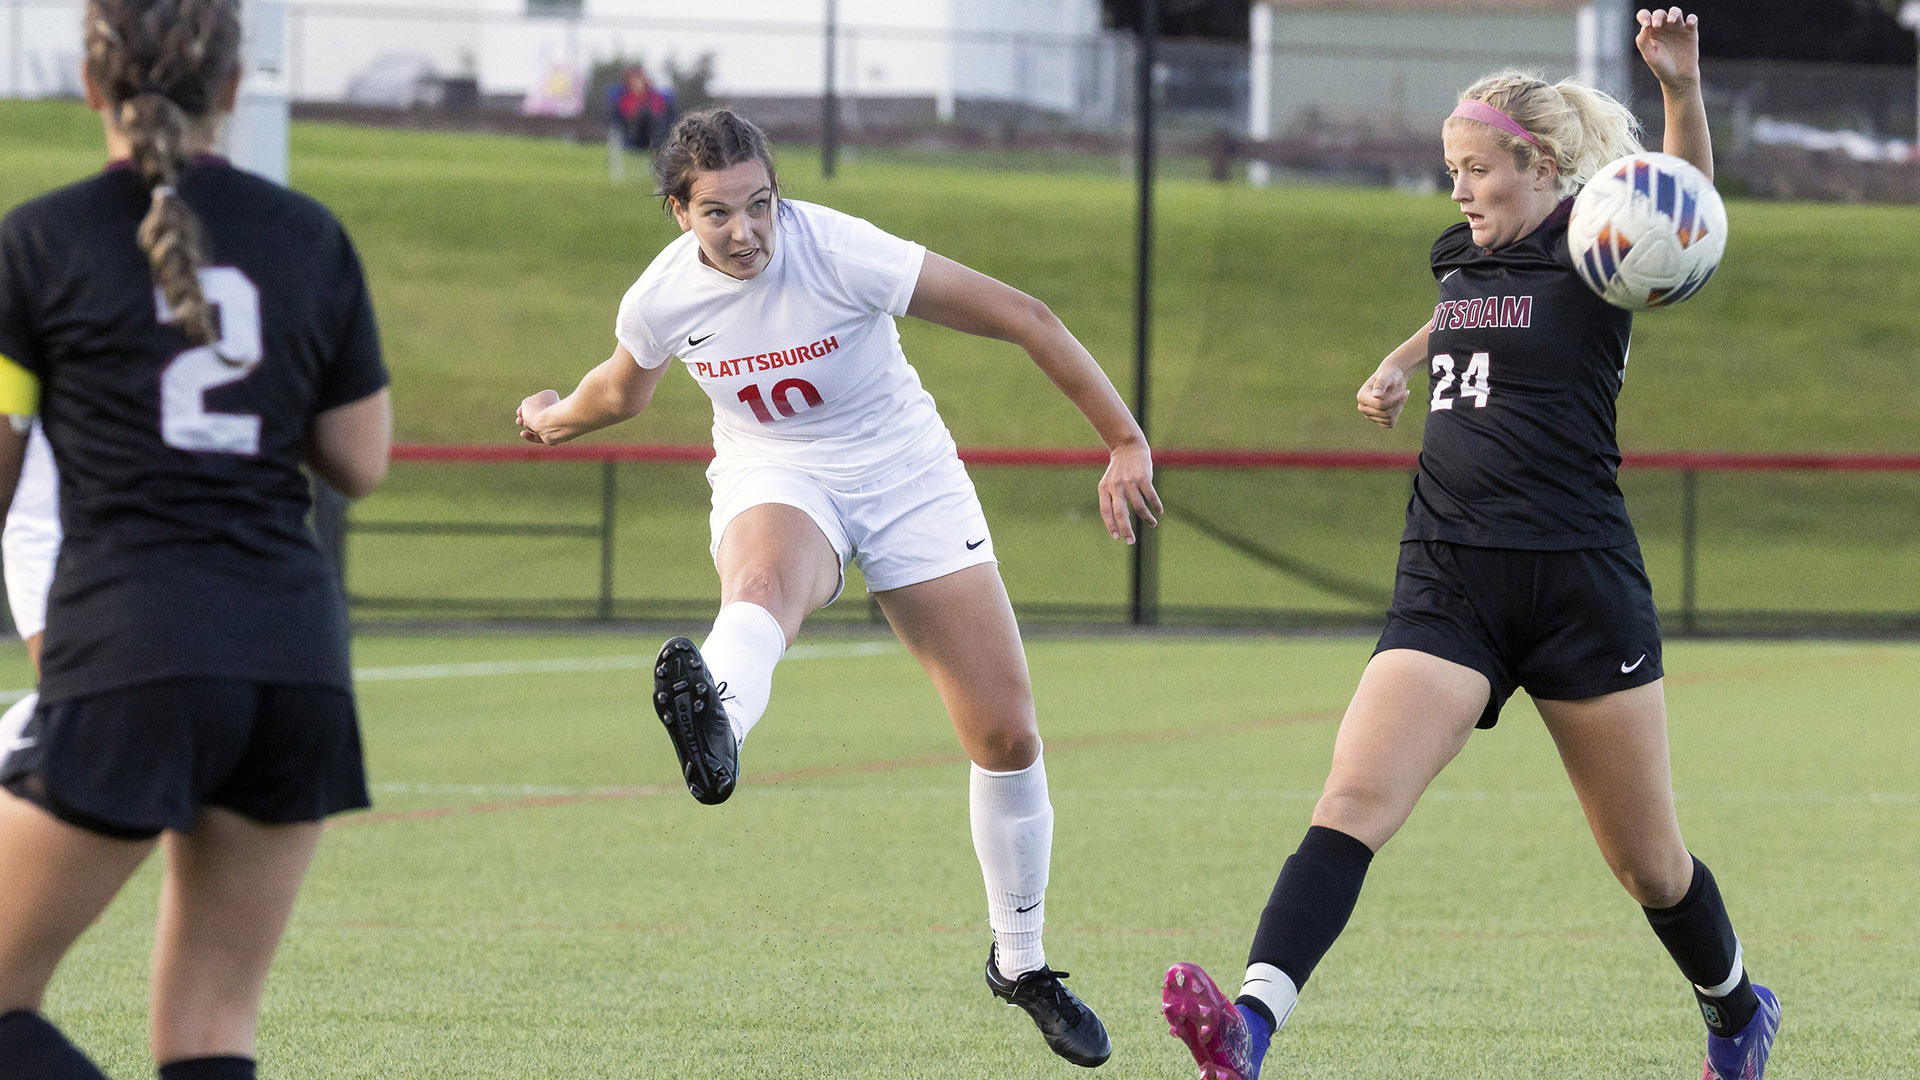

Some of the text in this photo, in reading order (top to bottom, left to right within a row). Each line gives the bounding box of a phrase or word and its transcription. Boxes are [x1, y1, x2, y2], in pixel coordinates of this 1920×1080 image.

[153, 265, 263, 455] 2
[696, 336, 840, 378] PLATTSBURGH
[1430, 352, 1492, 413] 24
[737, 378, 825, 424] 10
